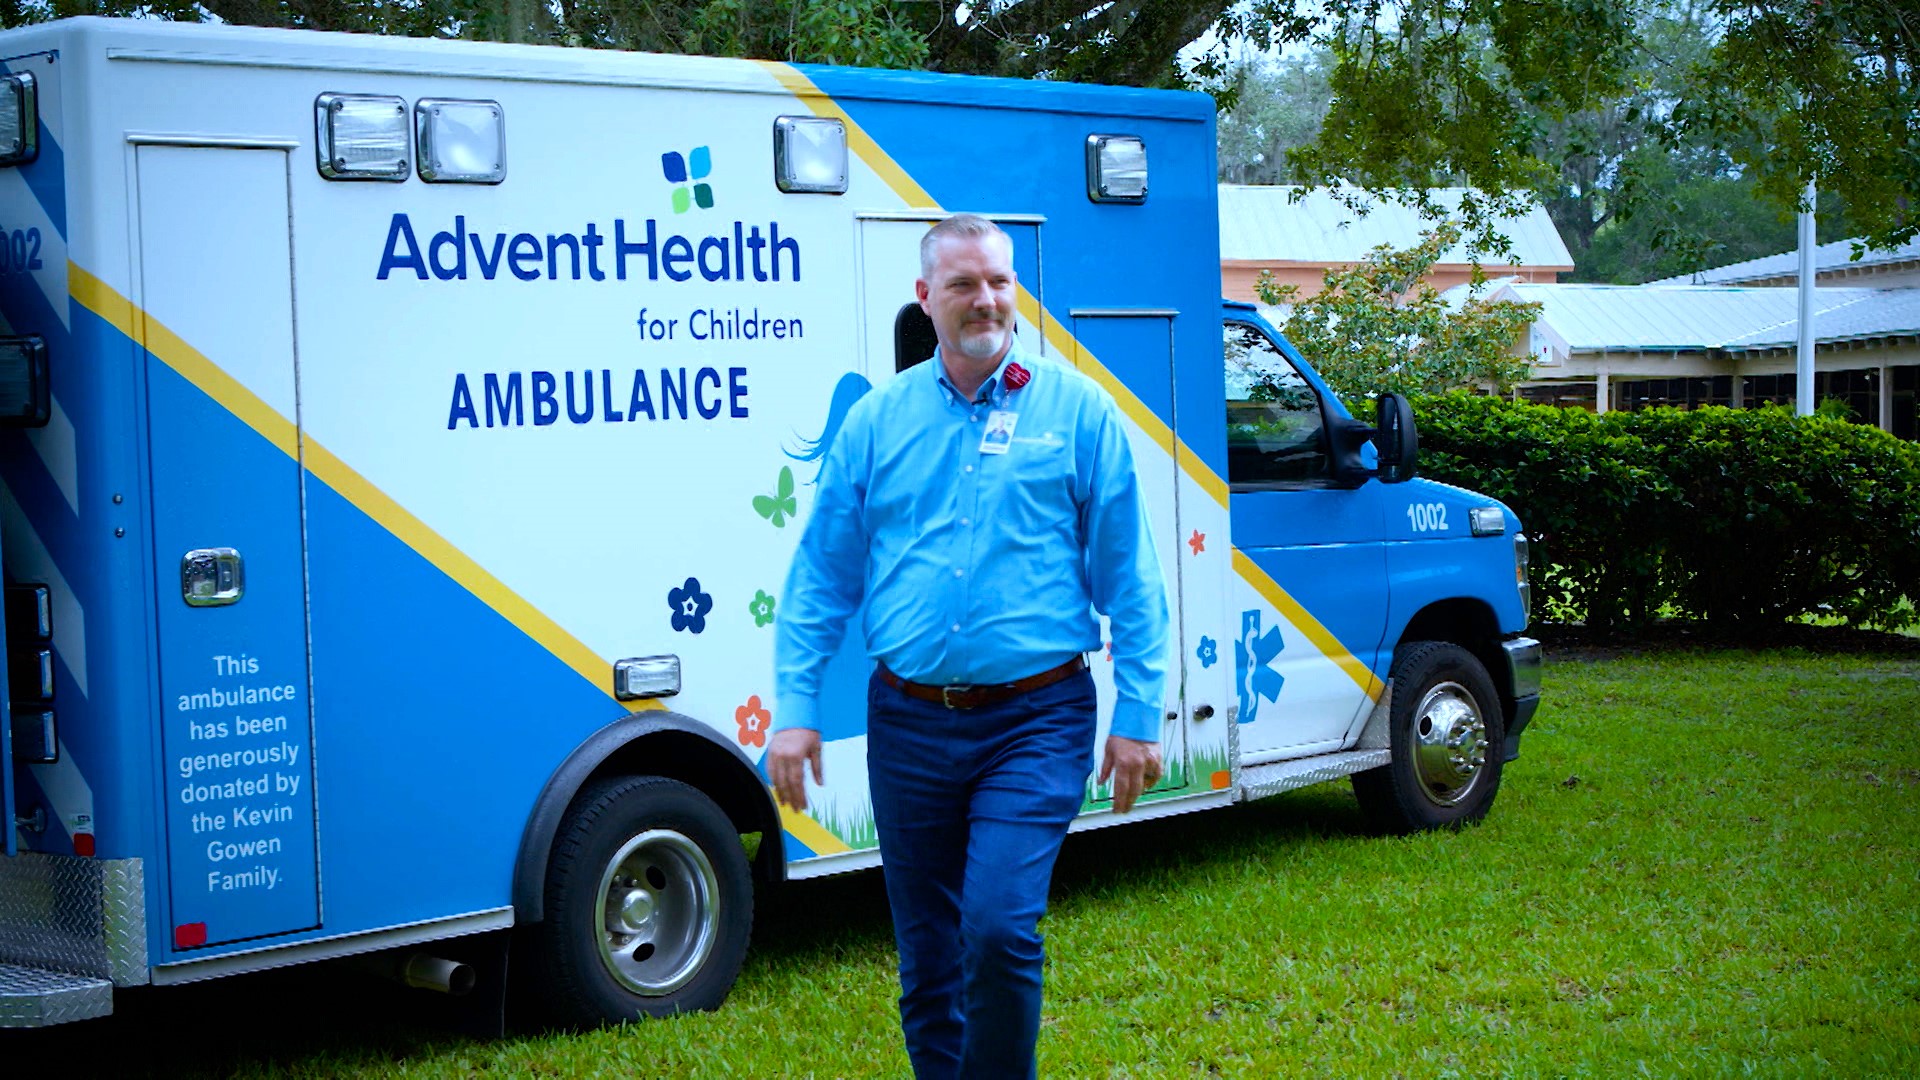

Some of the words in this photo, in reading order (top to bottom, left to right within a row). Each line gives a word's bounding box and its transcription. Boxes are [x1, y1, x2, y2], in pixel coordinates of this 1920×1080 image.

[376, 213, 801, 282] AdventHealth
[637, 307, 678, 340] for
[689, 308, 803, 340] Children
[447, 367, 749, 430] AMBULANCE
[1407, 502, 1449, 532] 1002
[212, 653, 260, 676] This
[178, 684, 296, 712] ambulance
[189, 719, 229, 740] has
[235, 715, 287, 736] been
[179, 741, 299, 778] generously
[181, 773, 269, 804] donated
[275, 771, 300, 796] by
[191, 811, 226, 834] the
[232, 802, 293, 828] Kevin
[207, 836, 281, 862] Gowen
[207, 865, 283, 892] Family.
